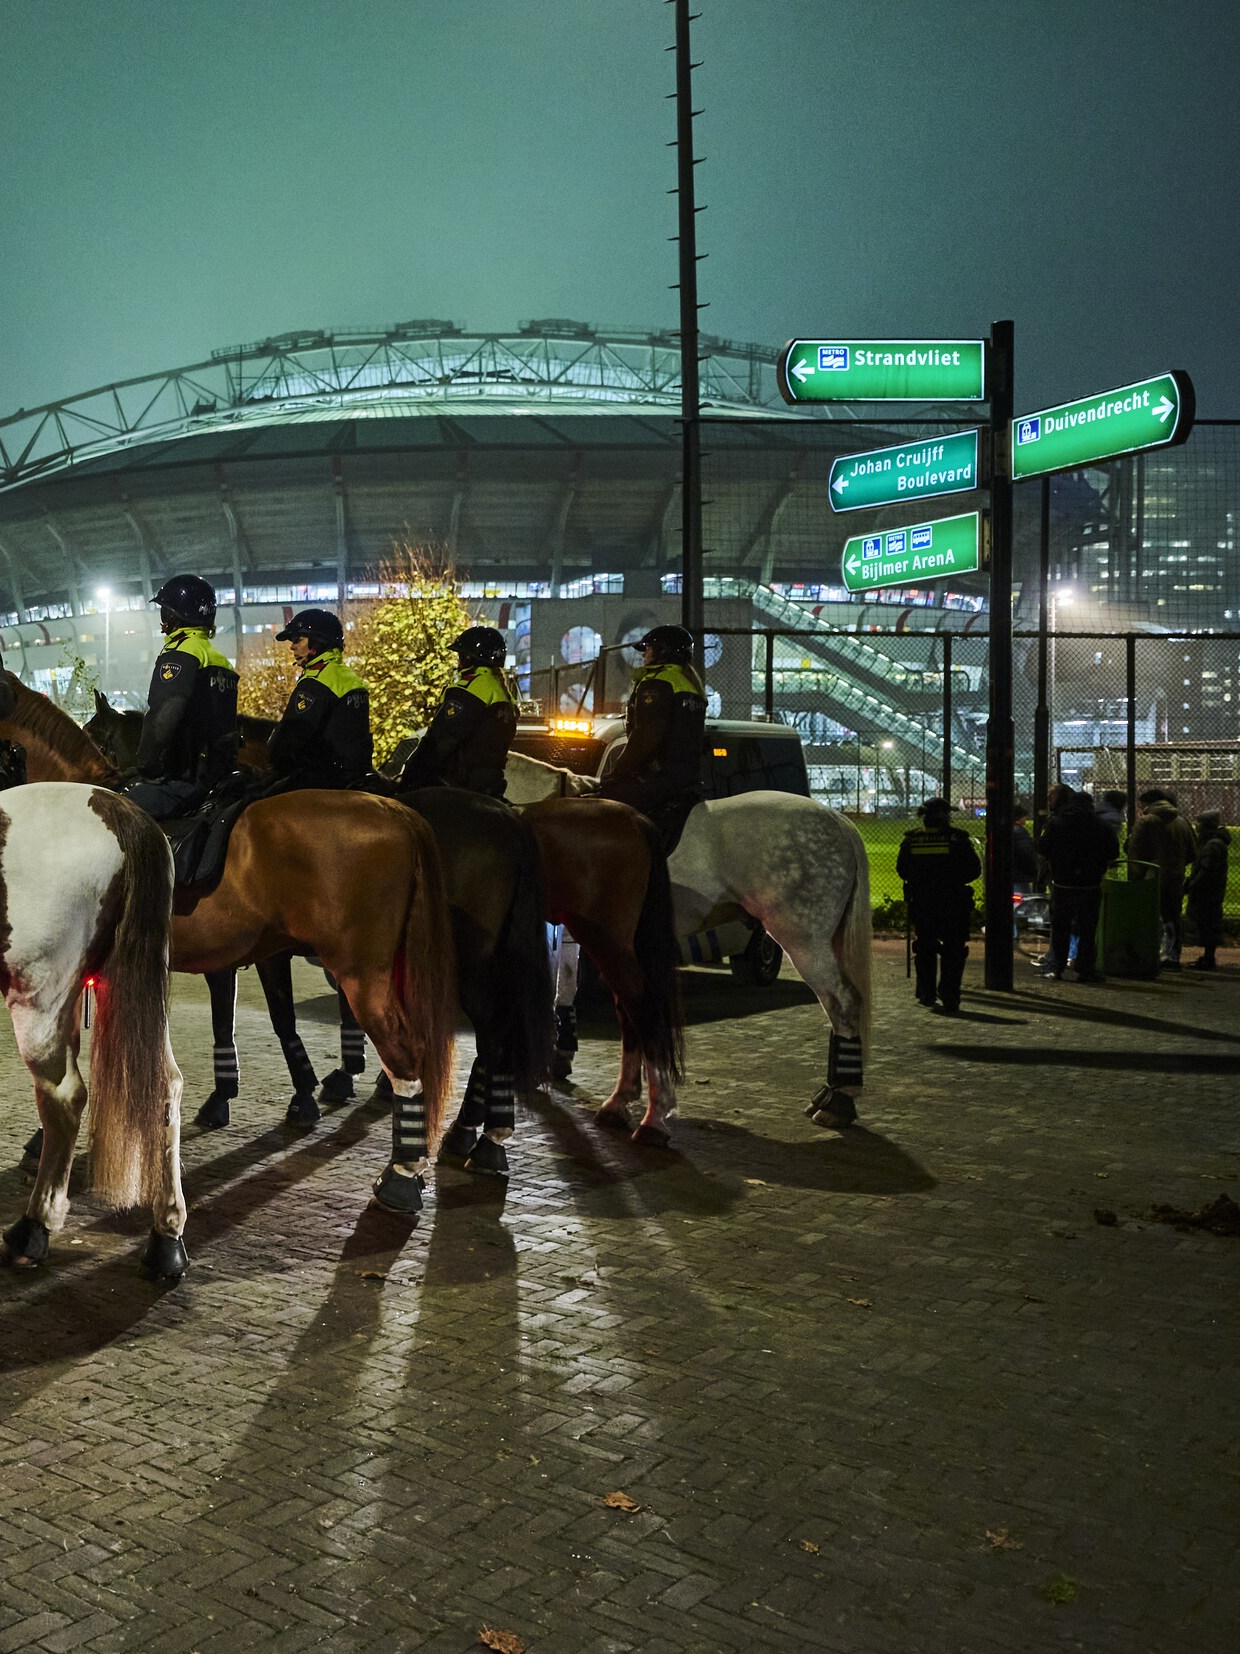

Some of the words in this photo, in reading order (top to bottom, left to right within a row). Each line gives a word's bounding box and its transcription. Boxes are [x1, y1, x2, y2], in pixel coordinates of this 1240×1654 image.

[854, 349, 961, 366] Strandvliet
[1044, 390, 1150, 435] Duivendrecht
[849, 459, 892, 477] Johan
[896, 445, 944, 467] Cruijff
[897, 463, 972, 491] Boulevard
[862, 559, 909, 581] Bijlmer
[912, 548, 955, 571] ArenA
